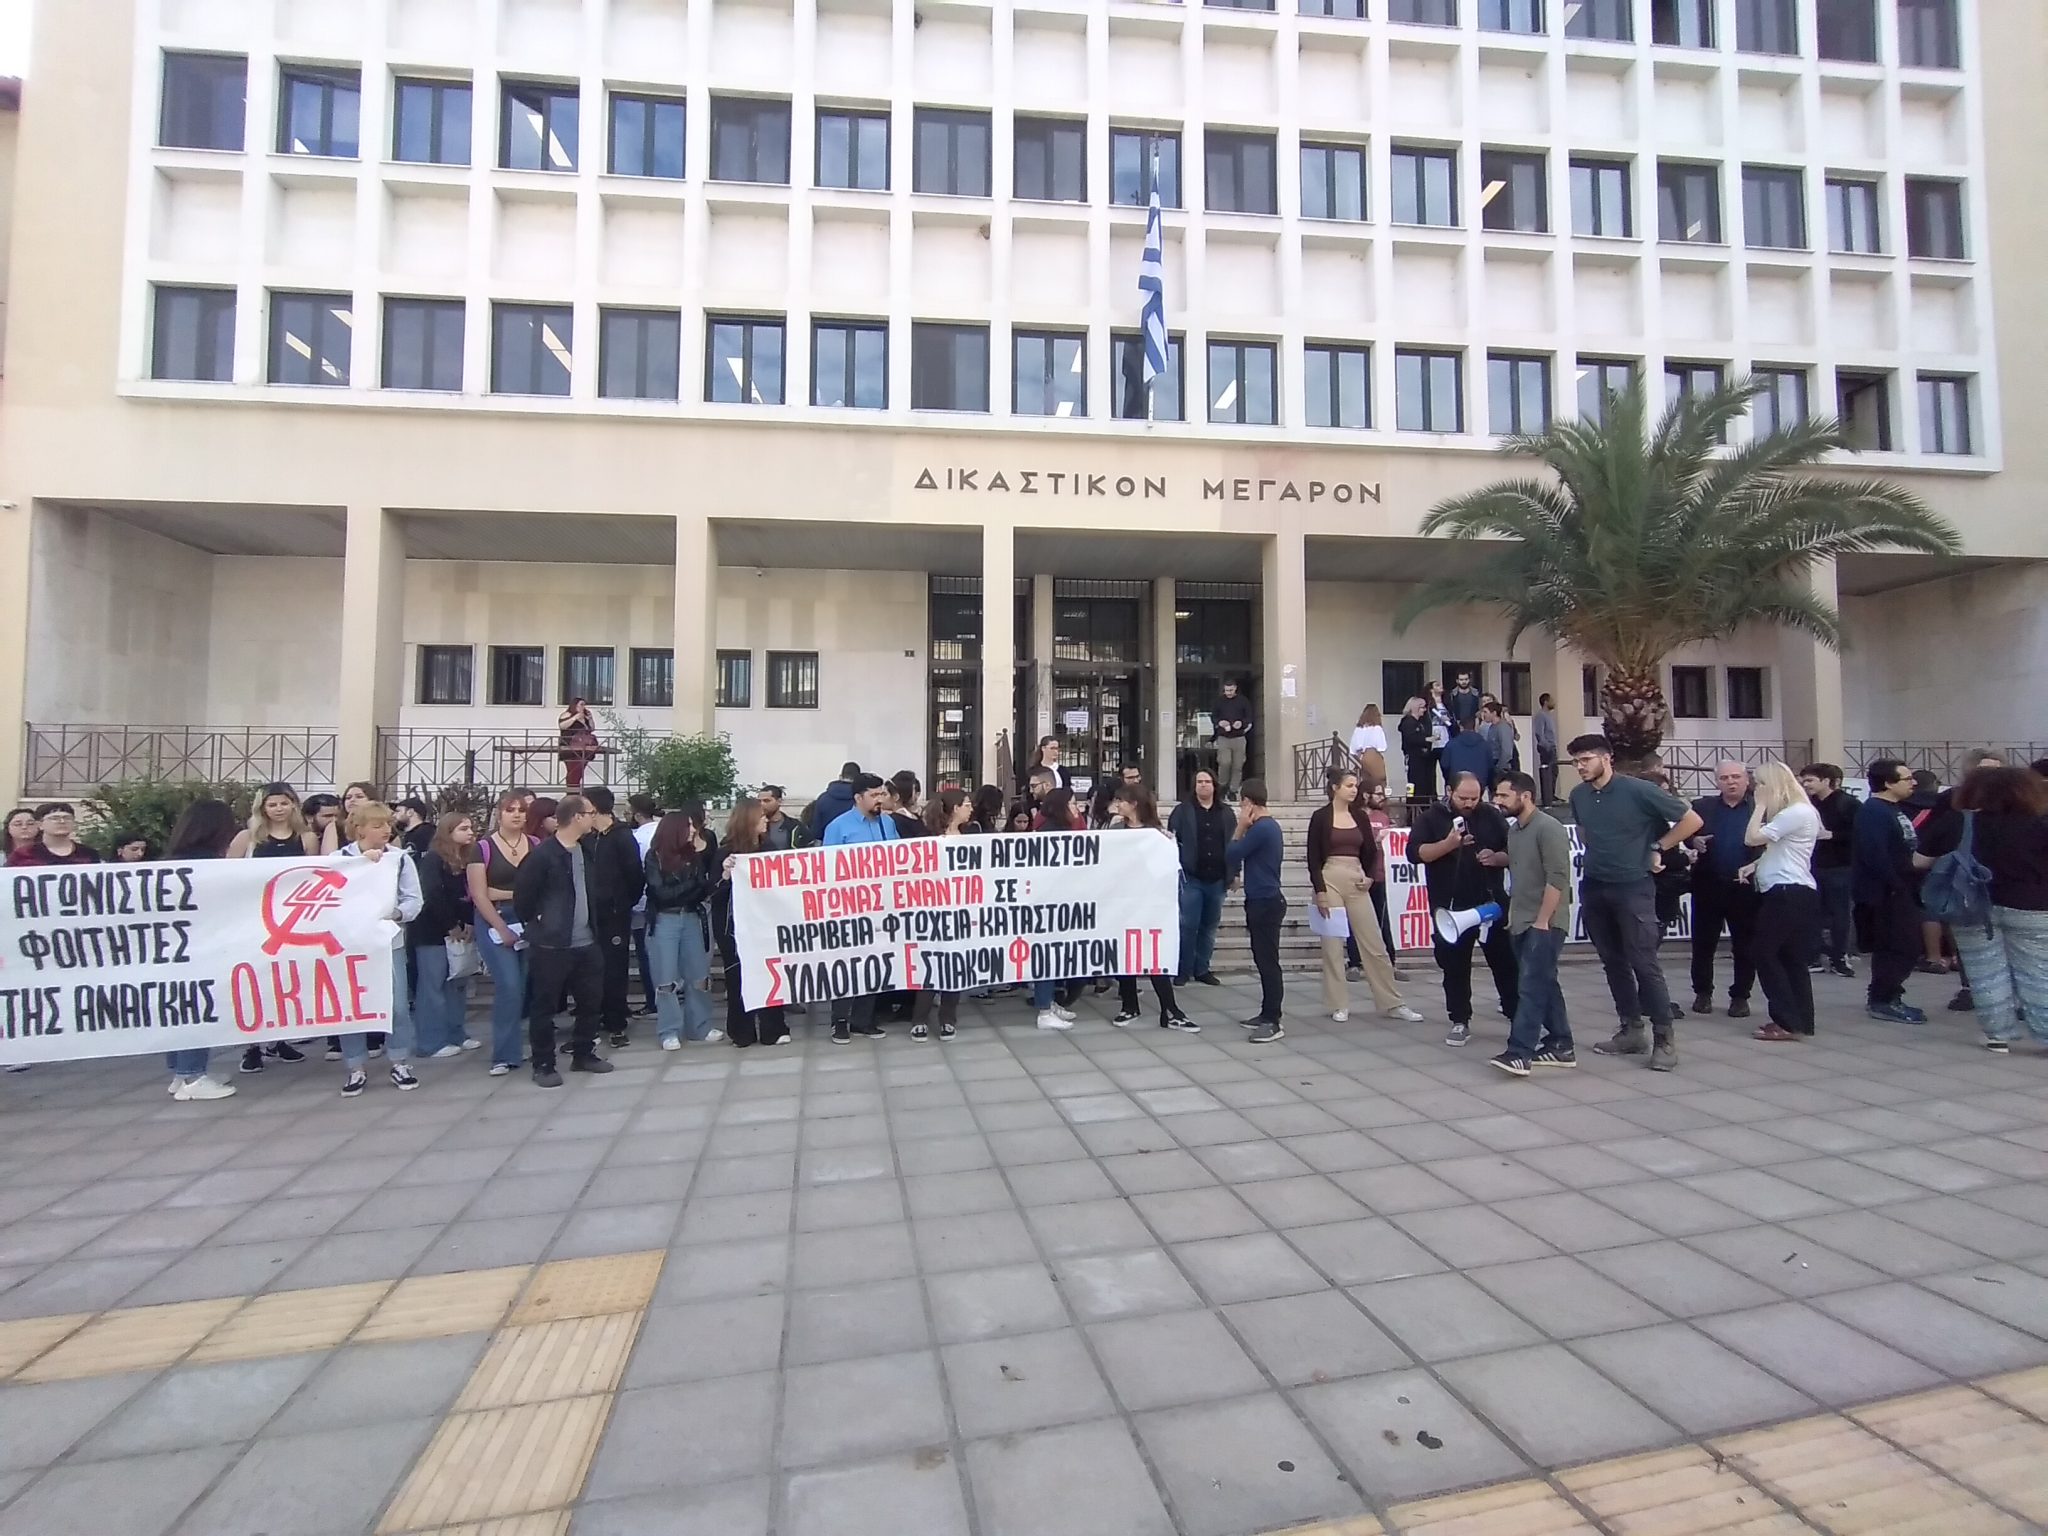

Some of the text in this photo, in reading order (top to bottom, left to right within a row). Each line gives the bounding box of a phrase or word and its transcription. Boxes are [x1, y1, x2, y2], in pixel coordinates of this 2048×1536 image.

[914, 467, 1382, 504] ΔΙΚΑΣΤΙΚΟΝ ΜΕΓΑΡΟΝ
[749, 835, 1100, 888] ΑΜΕΣΗ ΔΙΚΑΙΩΣΗ ΤΩΝ ΑΓΩΝΙΣΤΩΝ
[13, 867, 199, 918] ΑΓΩΝΙΣΤΕΣ
[802, 883, 885, 921] ΑΓΩΝΑΣ
[892, 875, 984, 909] ΕΝΑΝΤΙΑ
[18, 920, 192, 970] ΦΟΙΤΗΤΕΣ
[765, 929, 1169, 1007] ΣΥΛΛΟΓΟΣ ΕΣΤΙΑΚΩΝ ΦΟΙΤΗΤΩΝ Π.Ι.
[74, 979, 219, 1032] ΑΝΑΓΚΗΣ
[231, 954, 387, 1032] Ο.Κ.Δ.Ε.
